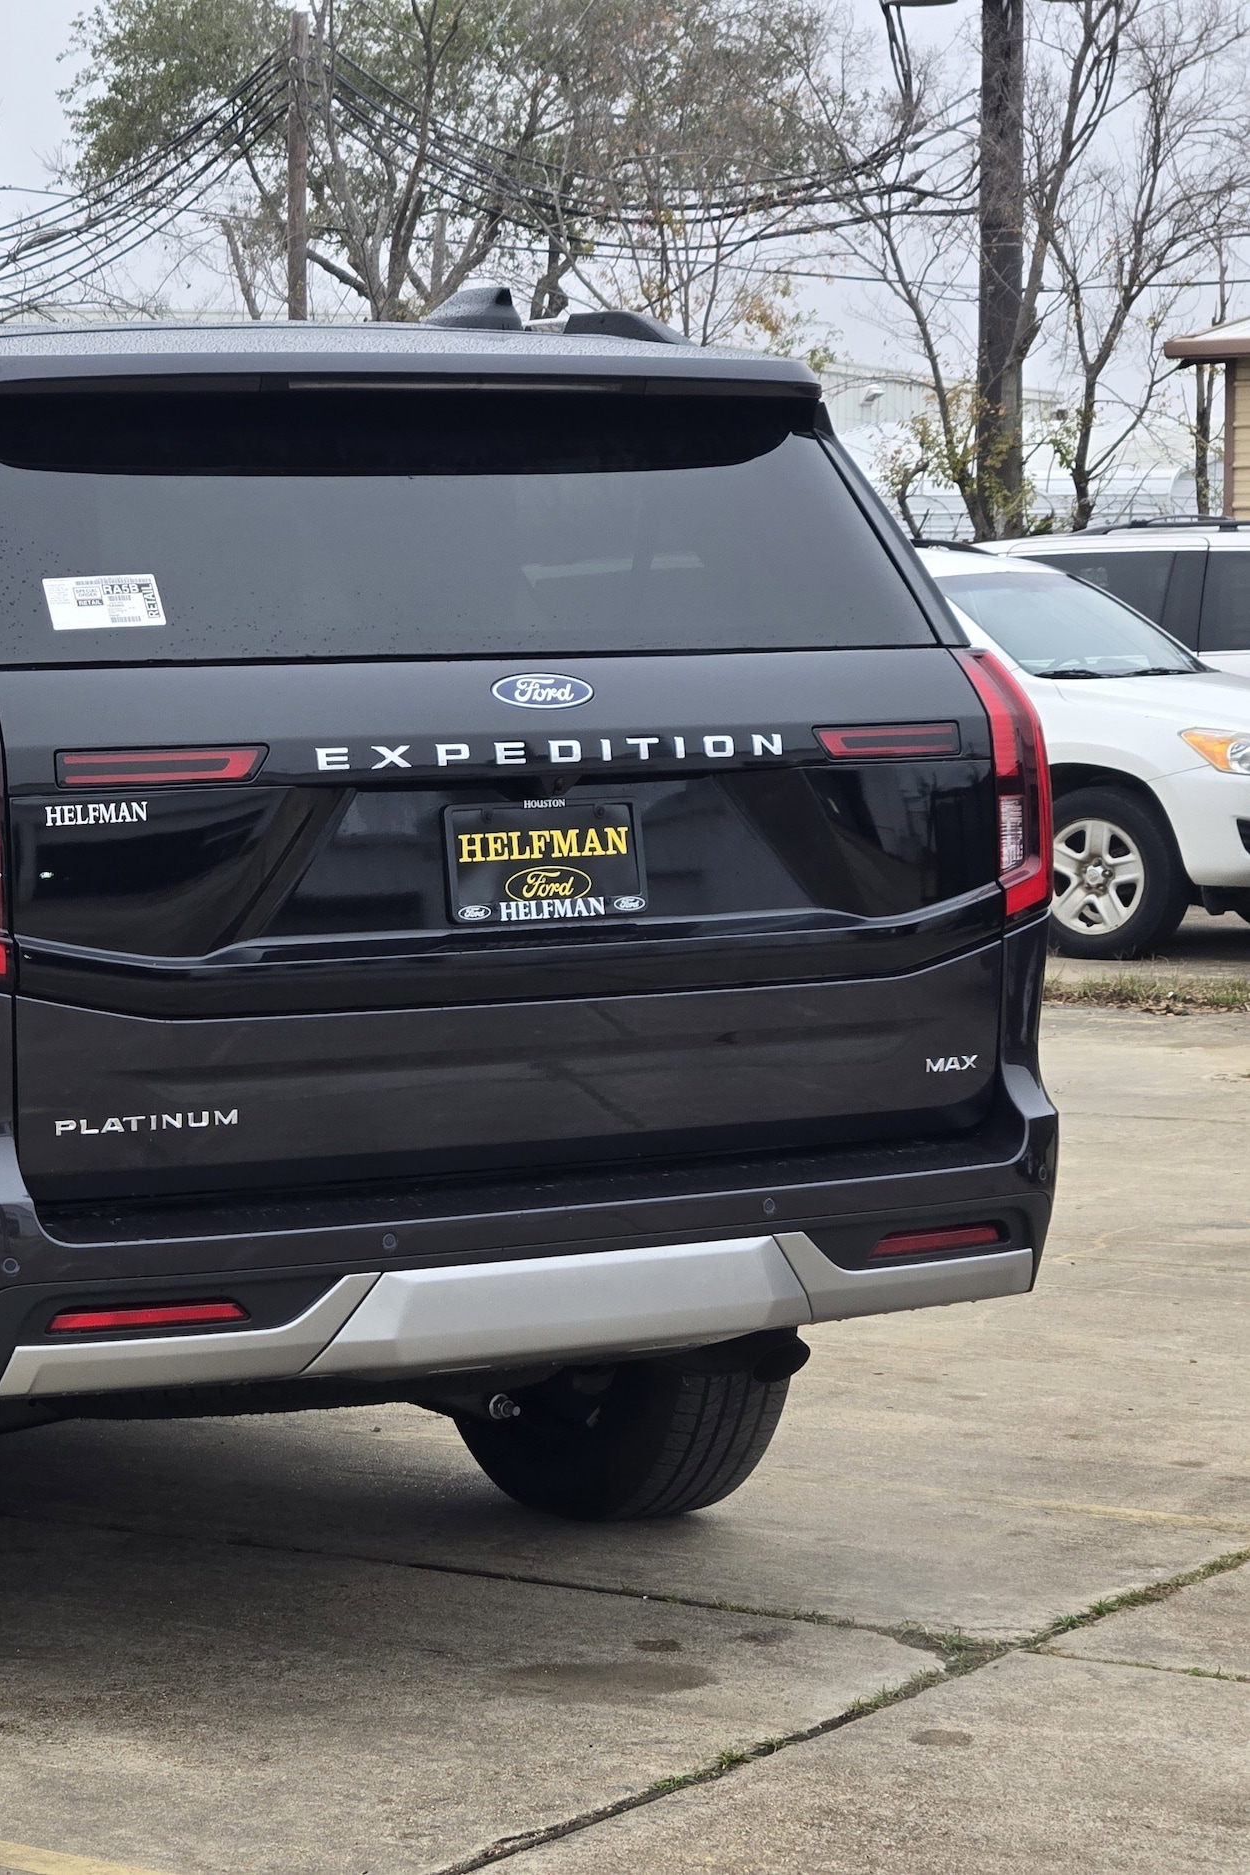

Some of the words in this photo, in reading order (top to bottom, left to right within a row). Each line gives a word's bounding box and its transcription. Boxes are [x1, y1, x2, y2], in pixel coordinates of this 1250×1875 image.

[103, 583, 139, 595] RA5B
[141, 583, 160, 618] RETAIL
[514, 677, 575, 703] Ford
[315, 733, 783, 771] EXPEDITION
[44, 801, 148, 827] HELFMAN
[523, 798, 566, 809] HOUSTON
[457, 826, 629, 863] HELFMAN
[522, 870, 575, 899] Ford
[499, 896, 606, 922] HELFMAN
[925, 1054, 979, 1073] MAX
[54, 1108, 239, 1137] PLATINUM
